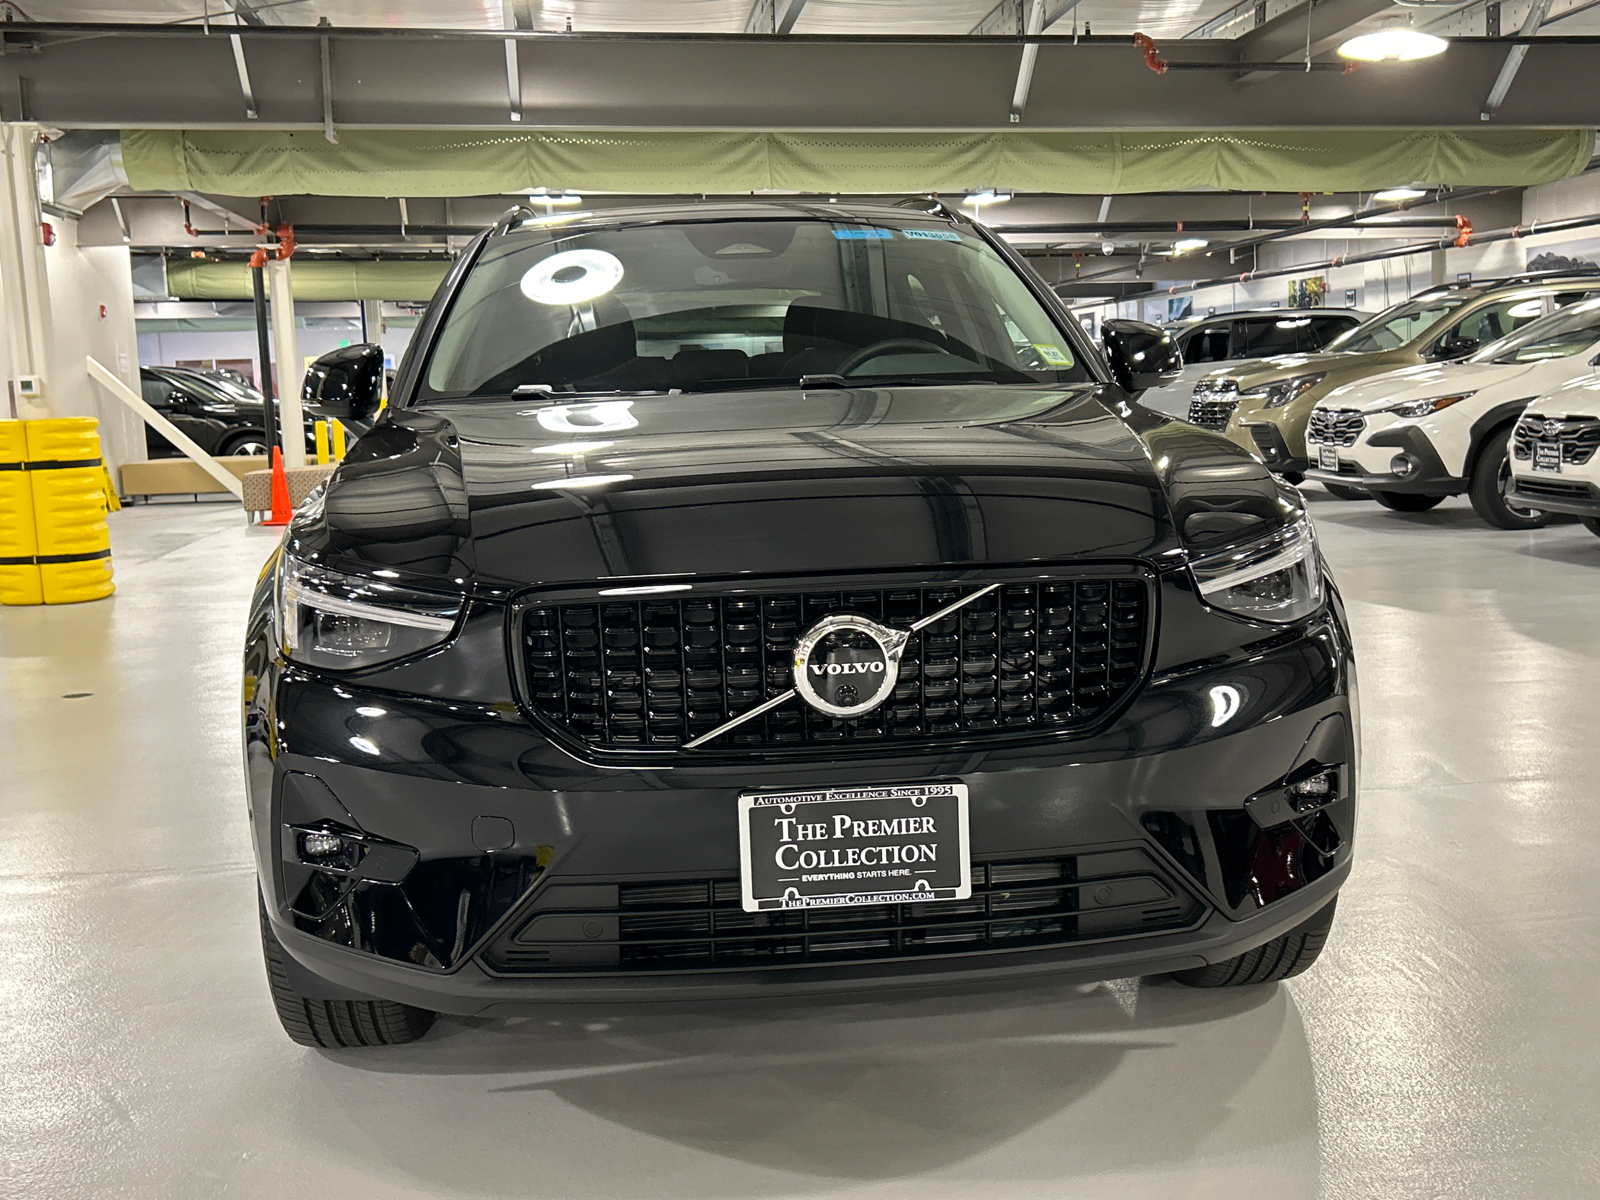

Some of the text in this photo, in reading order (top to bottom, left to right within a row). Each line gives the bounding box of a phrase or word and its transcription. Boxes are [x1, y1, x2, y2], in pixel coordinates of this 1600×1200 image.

[809, 661, 884, 675] VOLVO
[755, 786, 952, 806] AUTOMOTIVE EXCELLENCE SINCE 1995
[774, 814, 937, 842] THE PREMIER
[775, 843, 938, 870] COLLECTION
[801, 869, 912, 882] EVERYTHING STARTS HERE.
